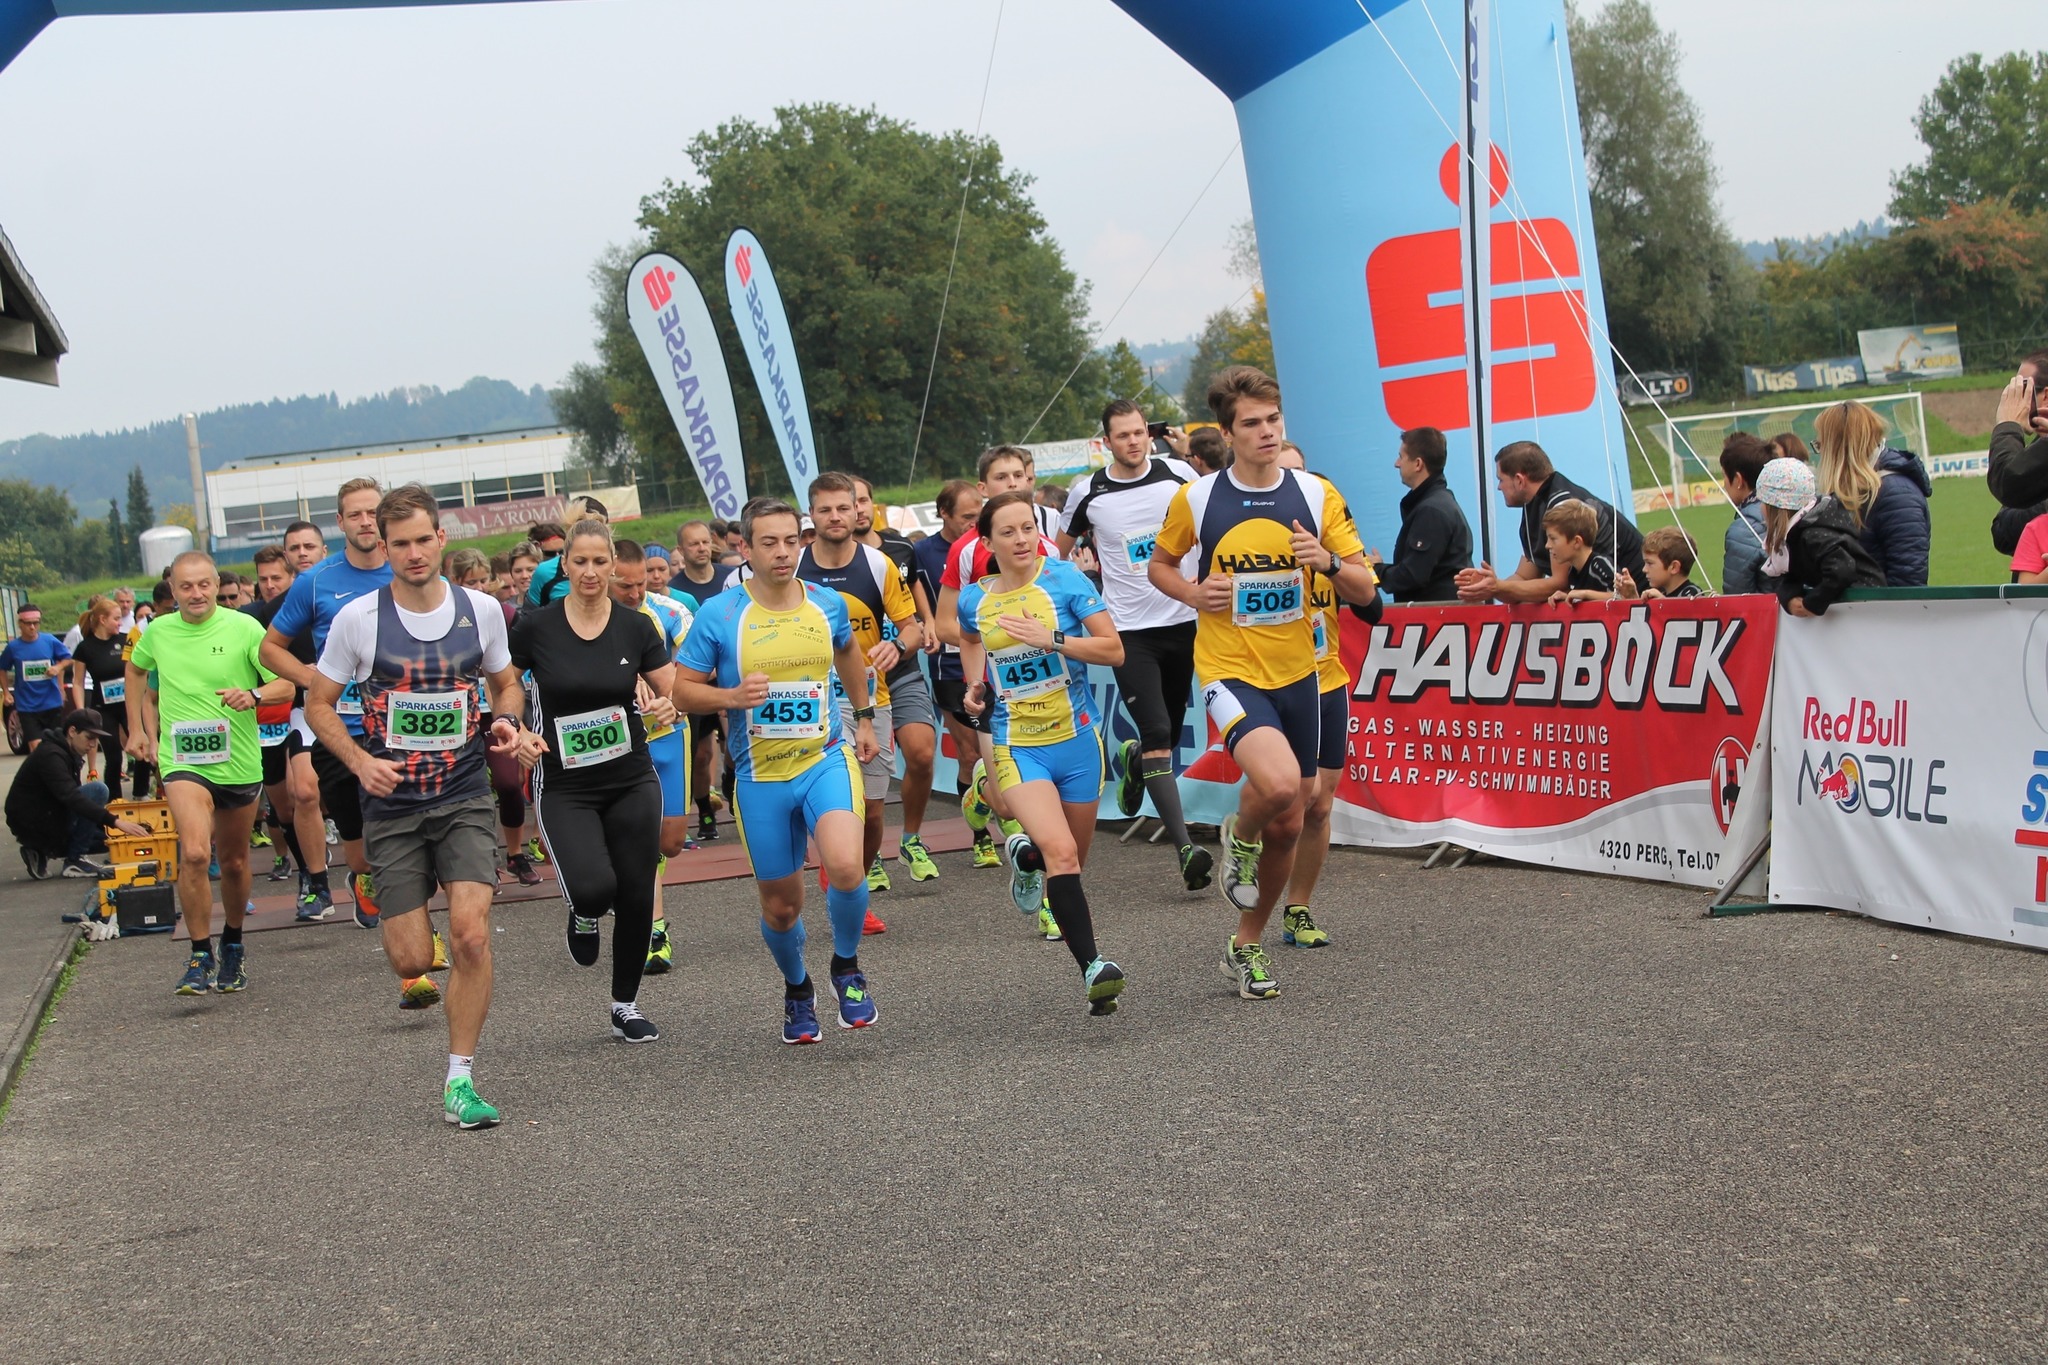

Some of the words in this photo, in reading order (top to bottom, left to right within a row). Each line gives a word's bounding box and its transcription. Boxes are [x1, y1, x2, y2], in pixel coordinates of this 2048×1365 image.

[1752, 367, 1798, 392] Tips
[1810, 362, 1857, 390] Tips
[1135, 541, 1156, 559] 49
[1238, 581, 1293, 590] SPARKASSE
[1245, 590, 1295, 613] 508
[994, 649, 1044, 666] SPARKASSE
[1005, 658, 1052, 686] 451
[395, 700, 452, 711] SPARKASSE
[760, 701, 813, 723] 453
[175, 726, 217, 735] SPARKASSE
[401, 712, 455, 735] 382
[561, 715, 612, 733] SPARKASSE
[1347, 716, 1395, 736] GAS
[1418, 719, 1504, 740] WASSER
[1533, 722, 1610, 745] HEIZUNG
[1803, 696, 1857, 743] Red
[1856, 699, 1908, 747] Bull
[181, 735, 221, 753] 388
[571, 725, 618, 753] 360
[1347, 740, 1611, 772] ALTERNATIVENERGIE
[1797, 748, 1948, 825] MOBILE
[1599, 839, 1631, 860] 4320
[1636, 843, 1673, 870] PERG,
